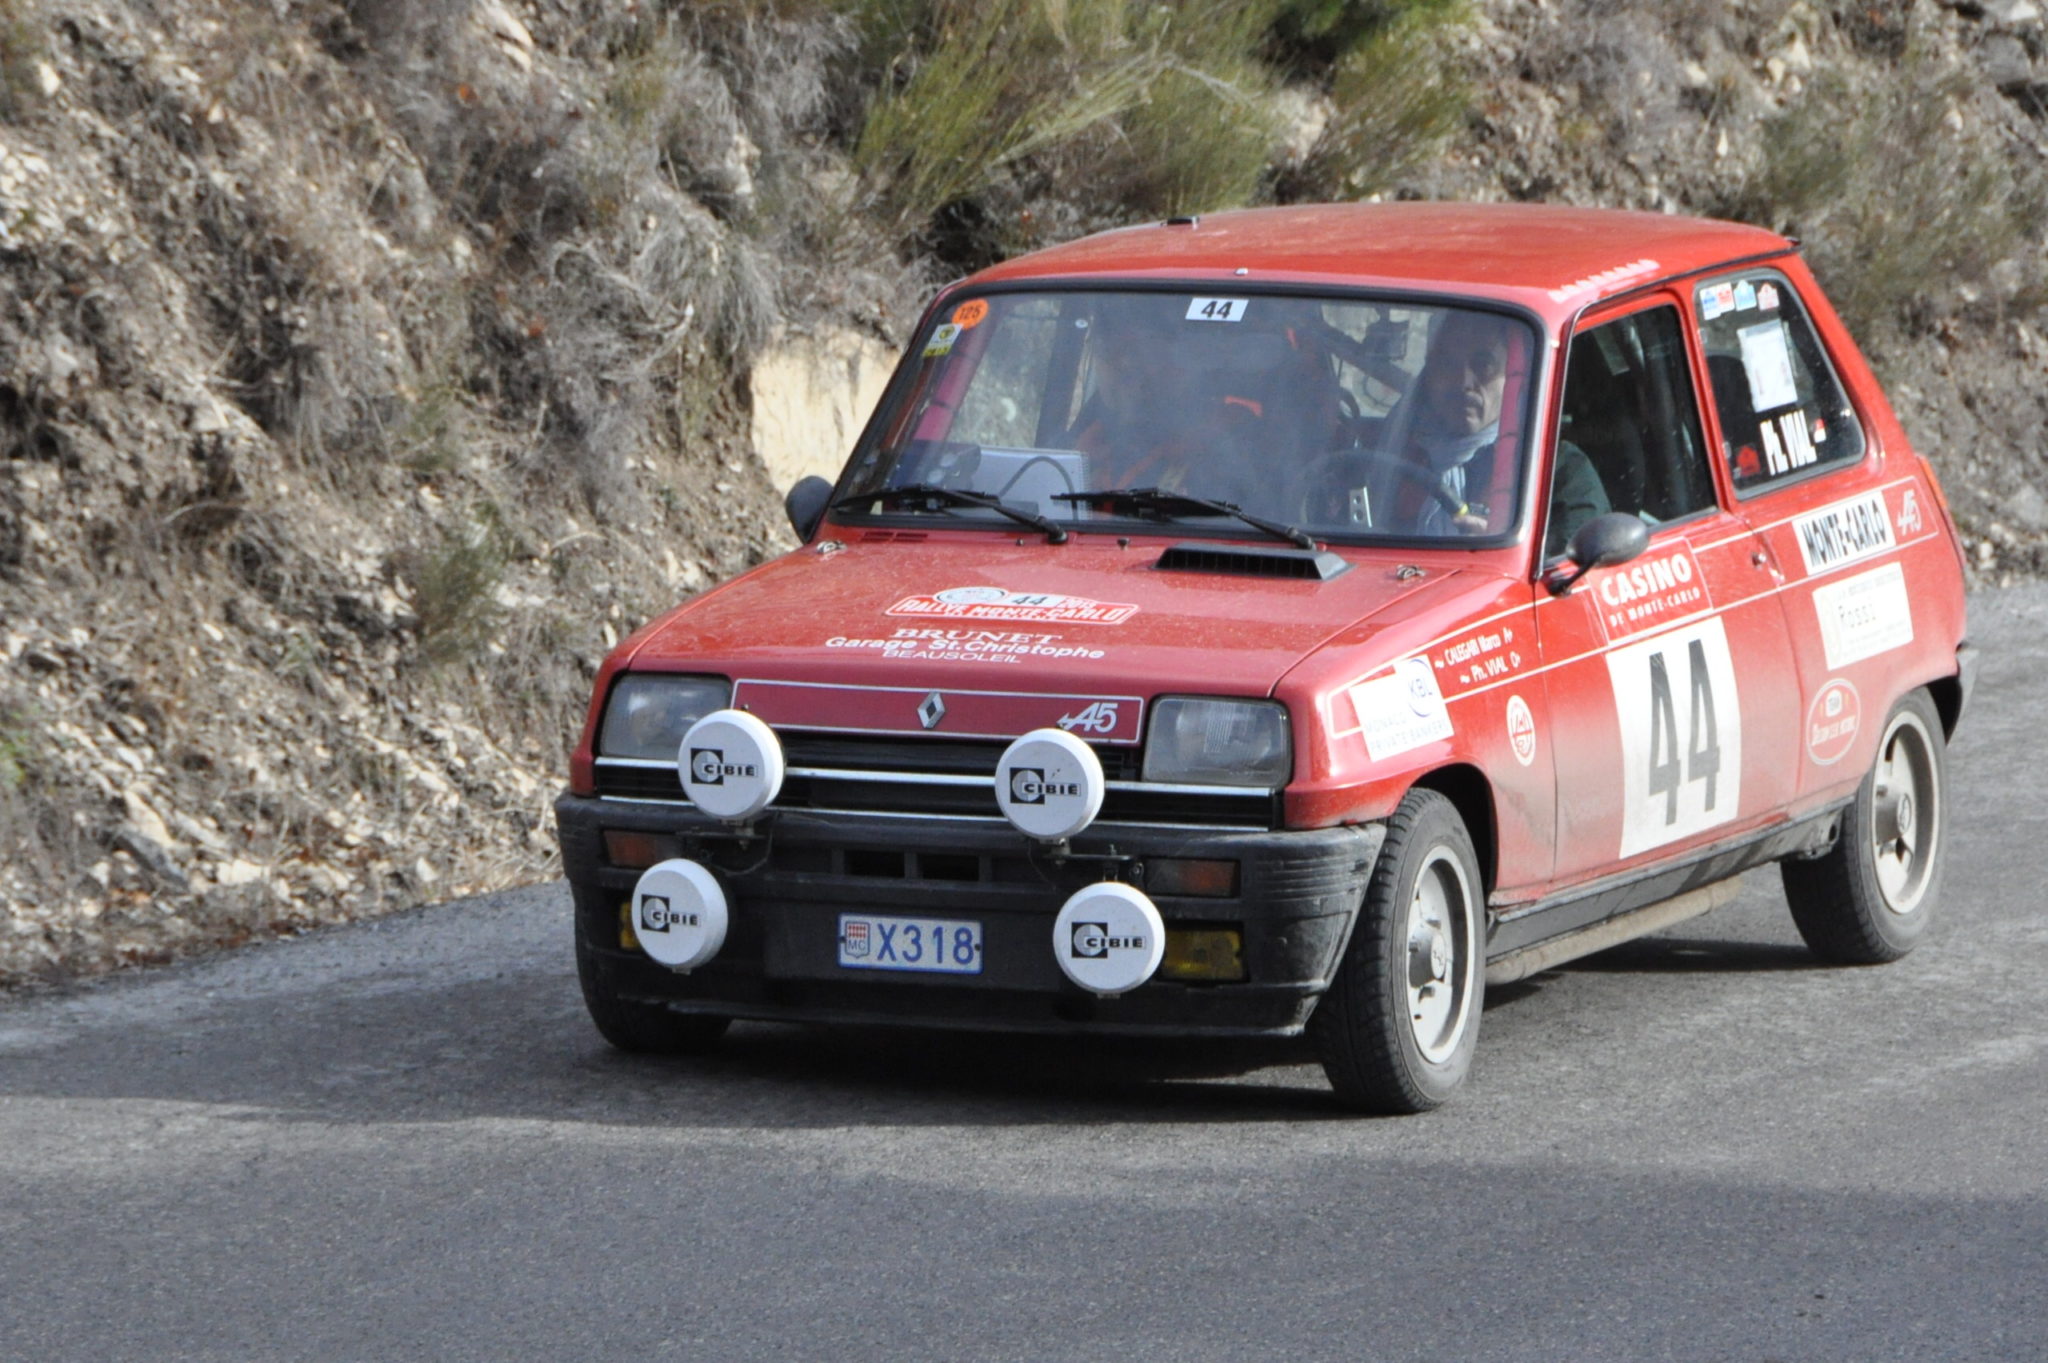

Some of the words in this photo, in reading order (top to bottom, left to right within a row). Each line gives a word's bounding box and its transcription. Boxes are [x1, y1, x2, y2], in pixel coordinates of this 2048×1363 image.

[1201, 301, 1232, 319] 44
[1801, 499, 1887, 567] MONTE-CARLO
[1601, 553, 1692, 606] CASINO
[895, 598, 967, 613] RALLYE
[1012, 595, 1048, 605] 44
[1609, 612, 1625, 627] DE
[1627, 587, 1701, 621] MONTE-CARLO
[825, 637, 917, 650] Garage
[889, 628, 1063, 644] BRUNET
[882, 650, 1021, 663] BEAUSOLEIL
[1366, 712, 1407, 733] MONACO
[1649, 638, 1720, 826] 44
[1370, 731, 1409, 752] PRIVATE
[848, 940, 866, 950] MC
[877, 923, 974, 965] X318
